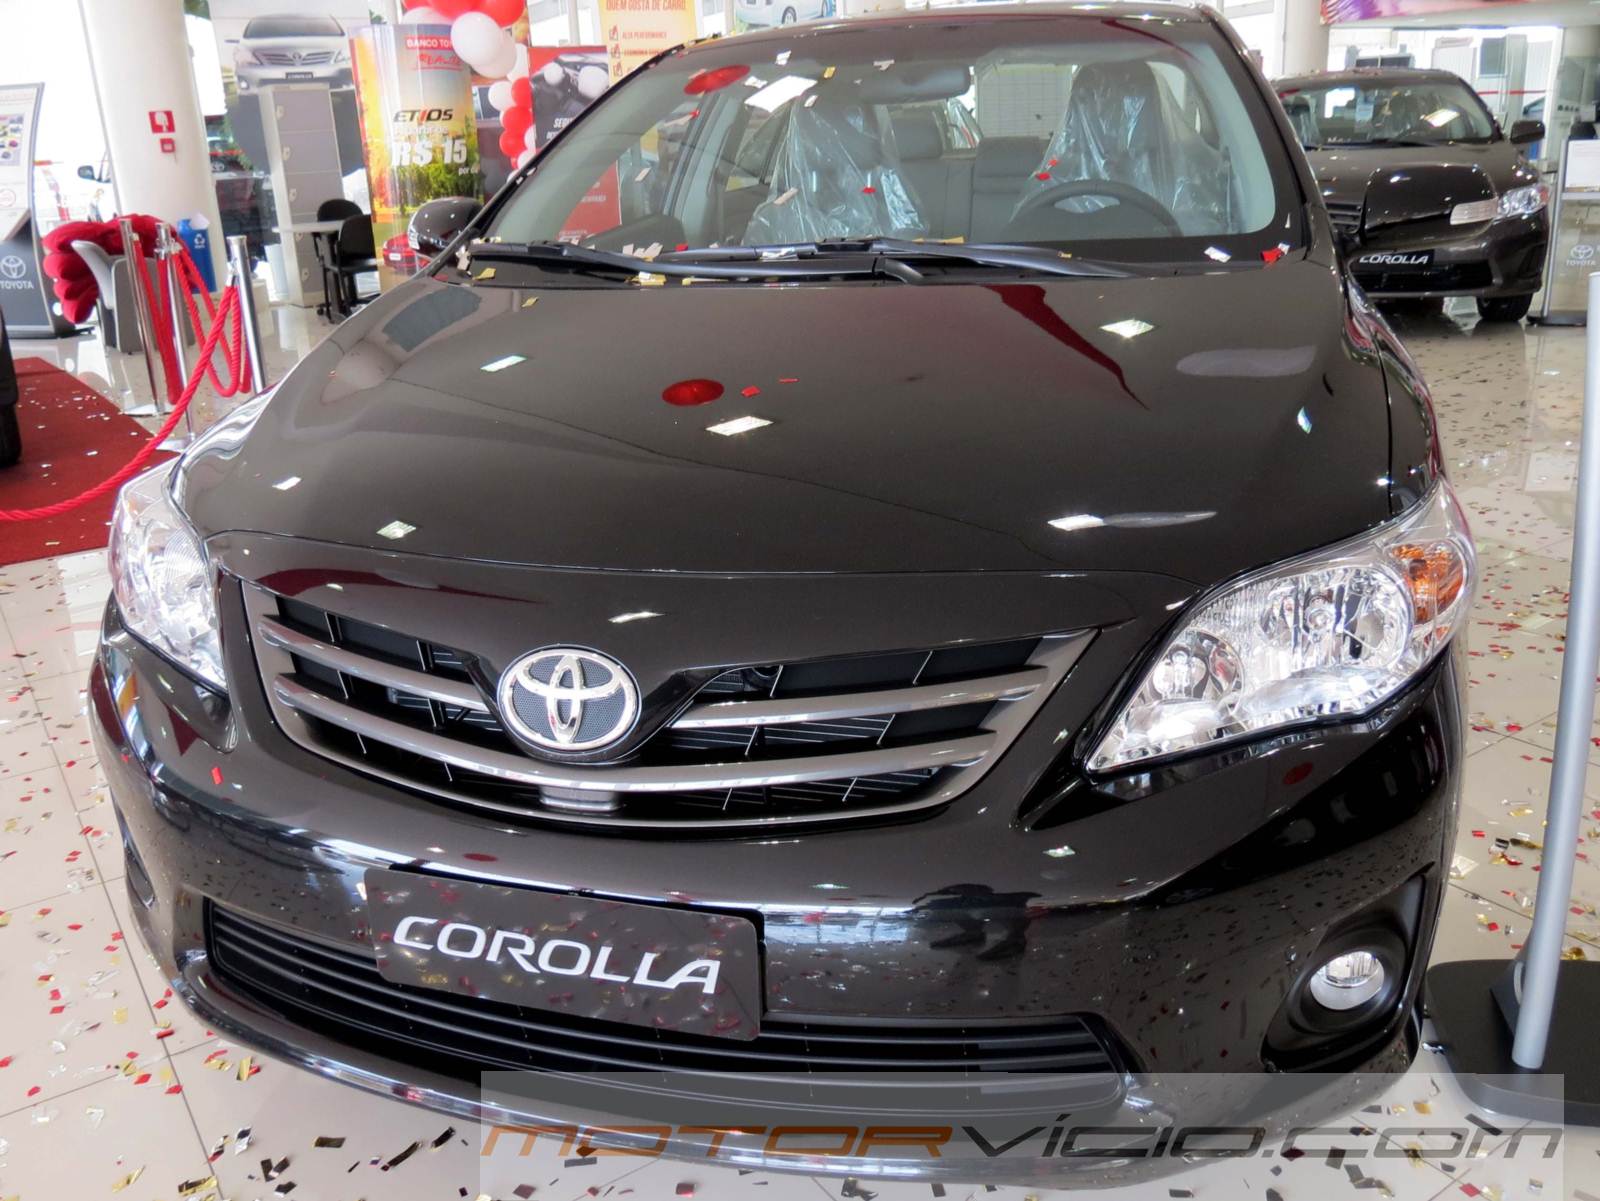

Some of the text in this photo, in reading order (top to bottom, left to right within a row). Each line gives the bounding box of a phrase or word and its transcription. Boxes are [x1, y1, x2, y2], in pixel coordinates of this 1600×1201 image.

[406, 38, 438, 48] BANCO
[393, 107, 453, 124] ETIOS
[443, 137, 467, 165] 15
[1359, 254, 1429, 265] COROLLA
[1565, 259, 1597, 267] TOYOTA
[0, 280, 34, 290] TOYOTA
[392, 915, 721, 994] COROLLA
